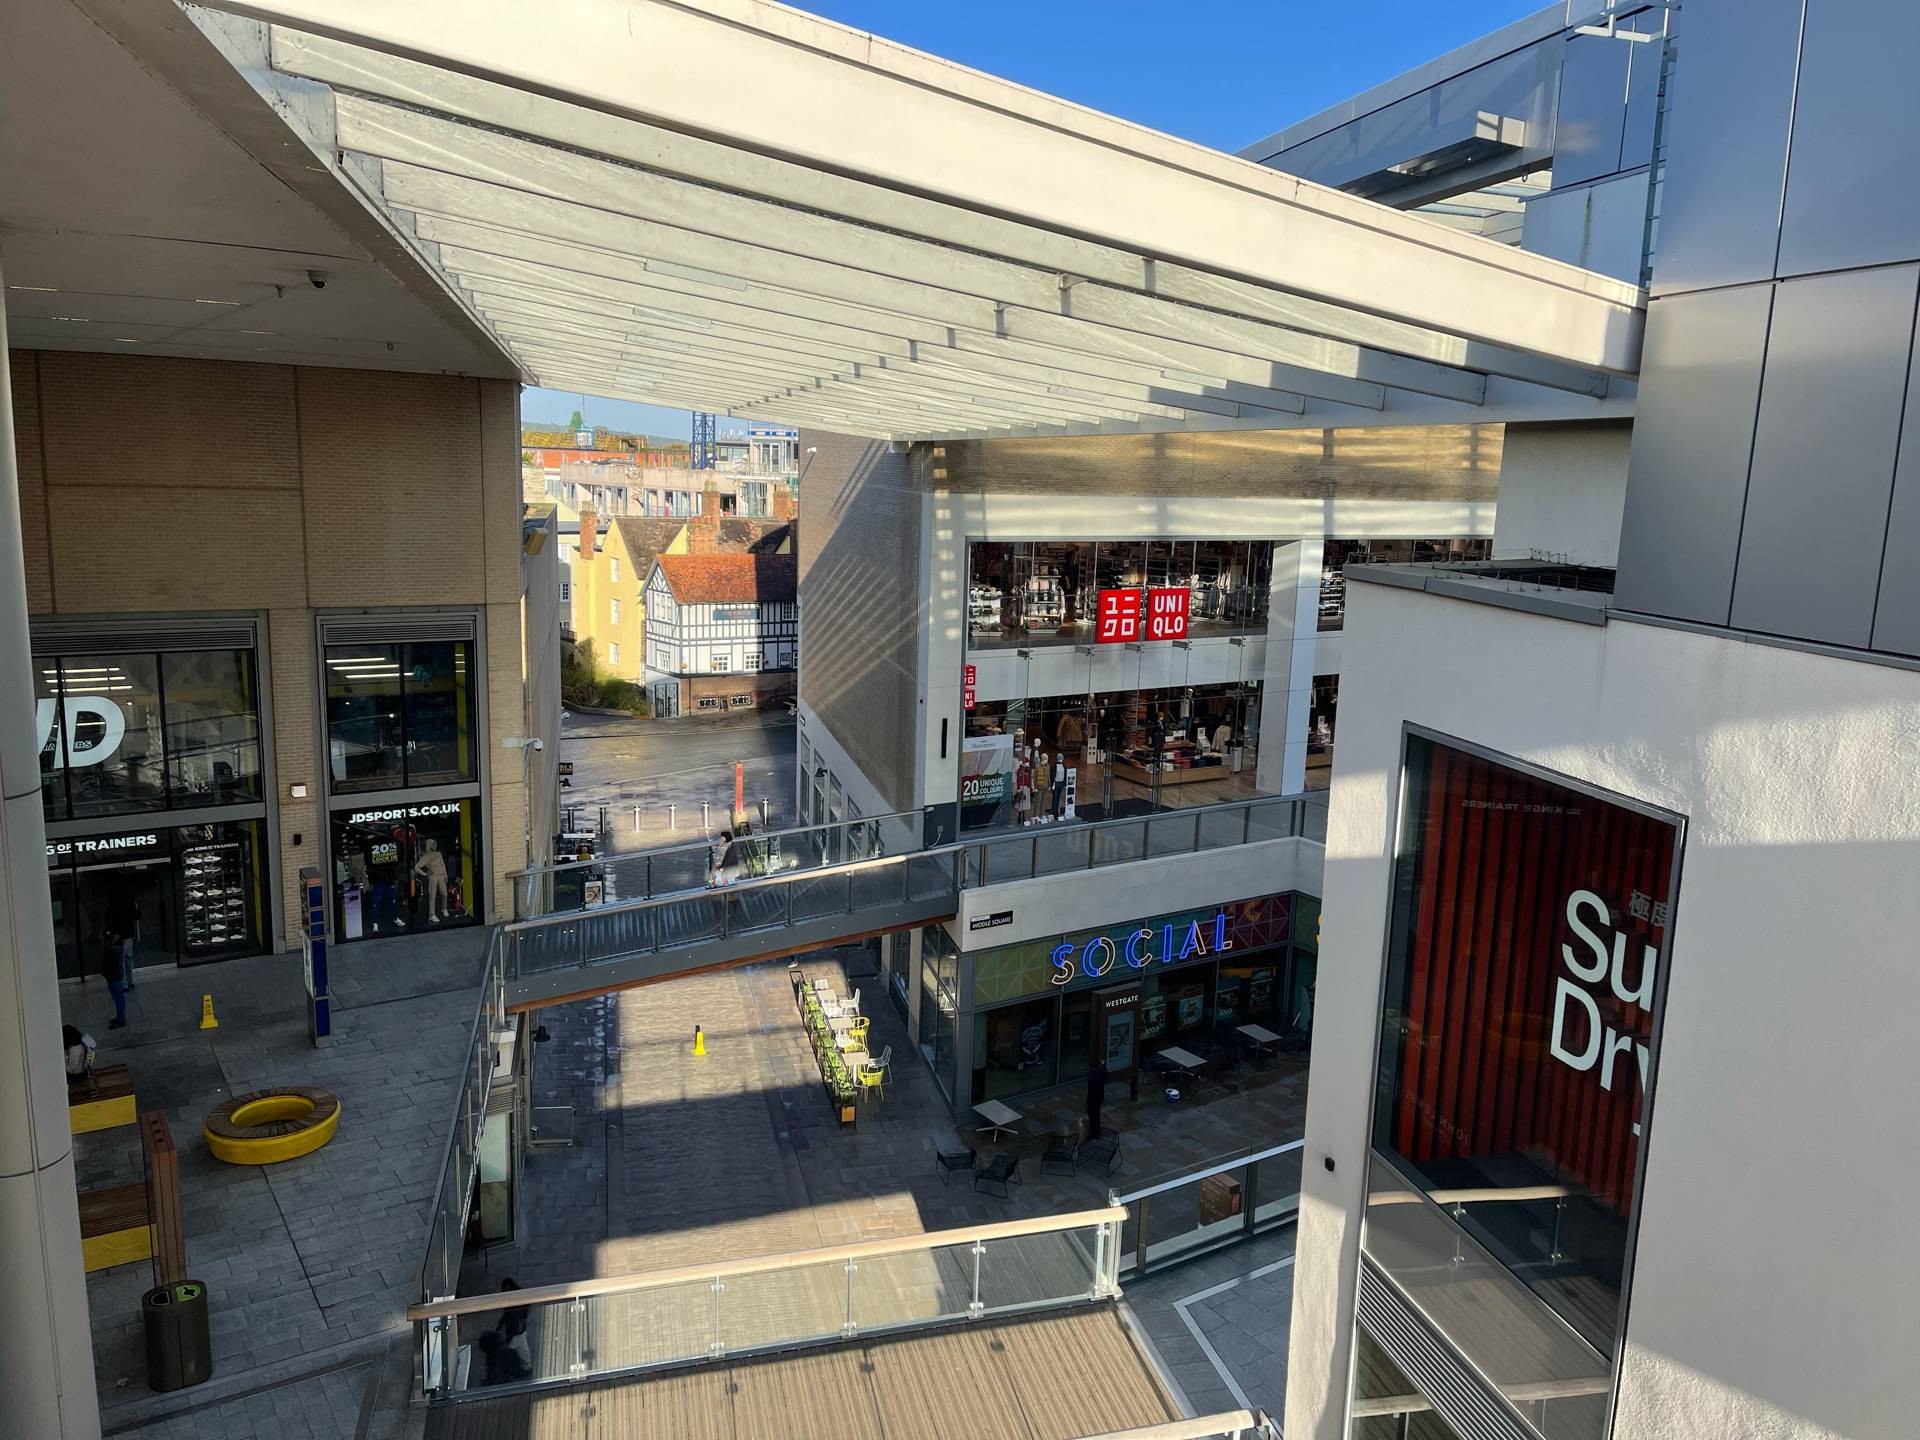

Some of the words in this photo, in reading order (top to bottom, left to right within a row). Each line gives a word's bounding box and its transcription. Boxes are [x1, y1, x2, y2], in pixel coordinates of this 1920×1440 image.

[1154, 594, 1183, 614] UNI
[1153, 616, 1184, 638] QLO
[963, 779, 979, 797] 20
[979, 785, 1004, 795] COLOURS
[980, 777, 1004, 788] UNIQUE
[348, 802, 460, 824] JDSPORTS.CO.UK
[57, 843, 72, 854] OF
[75, 834, 157, 852] TRAINERS
[371, 842, 397, 855] 20%
[1052, 913, 1233, 985] SOCIAL
[1105, 994, 1139, 1008] WESTGATE
